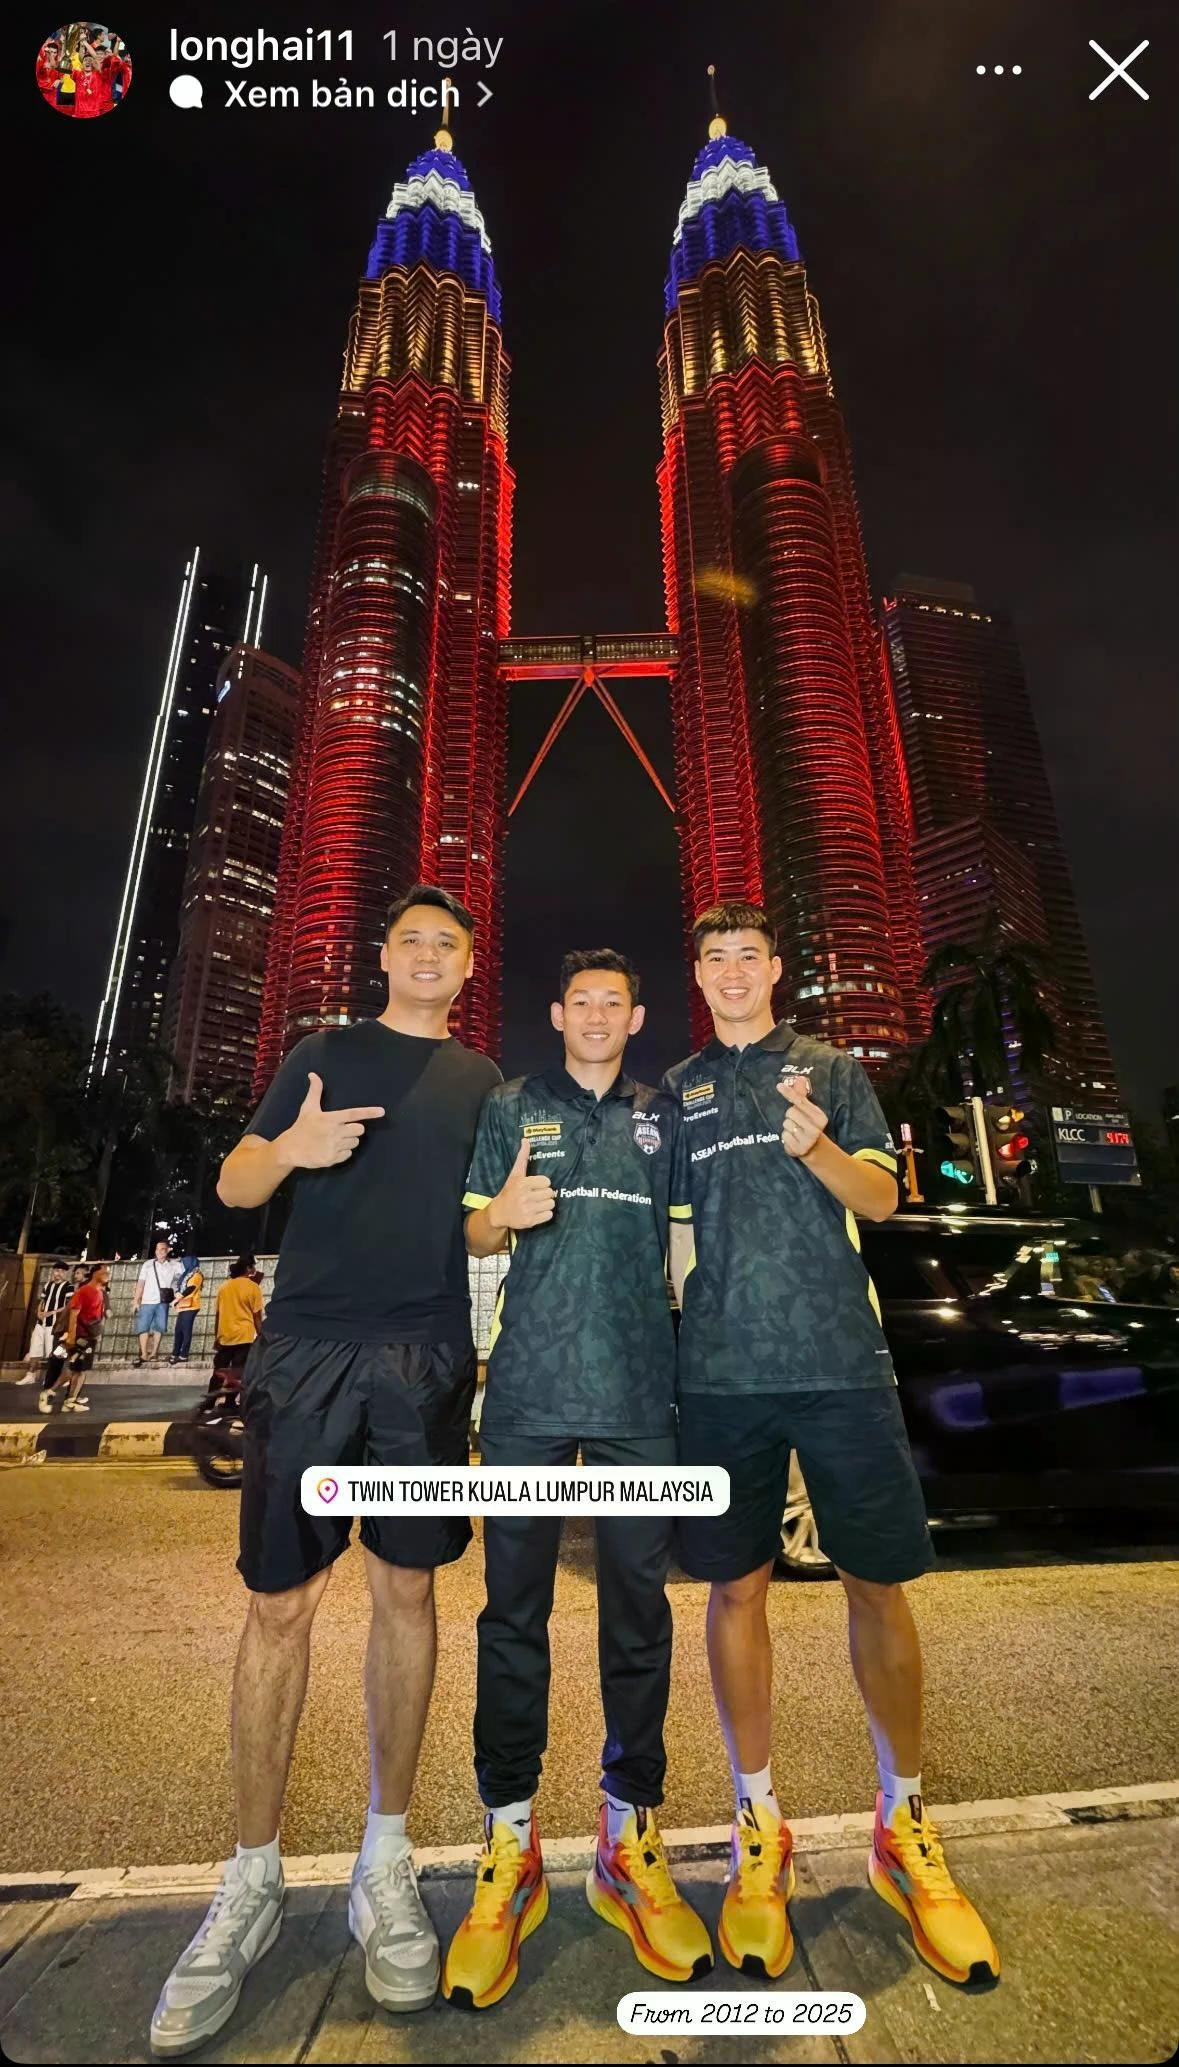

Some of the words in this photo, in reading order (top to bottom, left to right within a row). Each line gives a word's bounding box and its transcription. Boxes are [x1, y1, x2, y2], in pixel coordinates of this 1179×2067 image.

[1058, 1127, 1086, 1141] KLCC
[718, 1134, 755, 1151] Football
[529, 1150, 566, 1161] roEvents
[560, 1186, 599, 1198] Football
[601, 1188, 652, 1205] Federation
